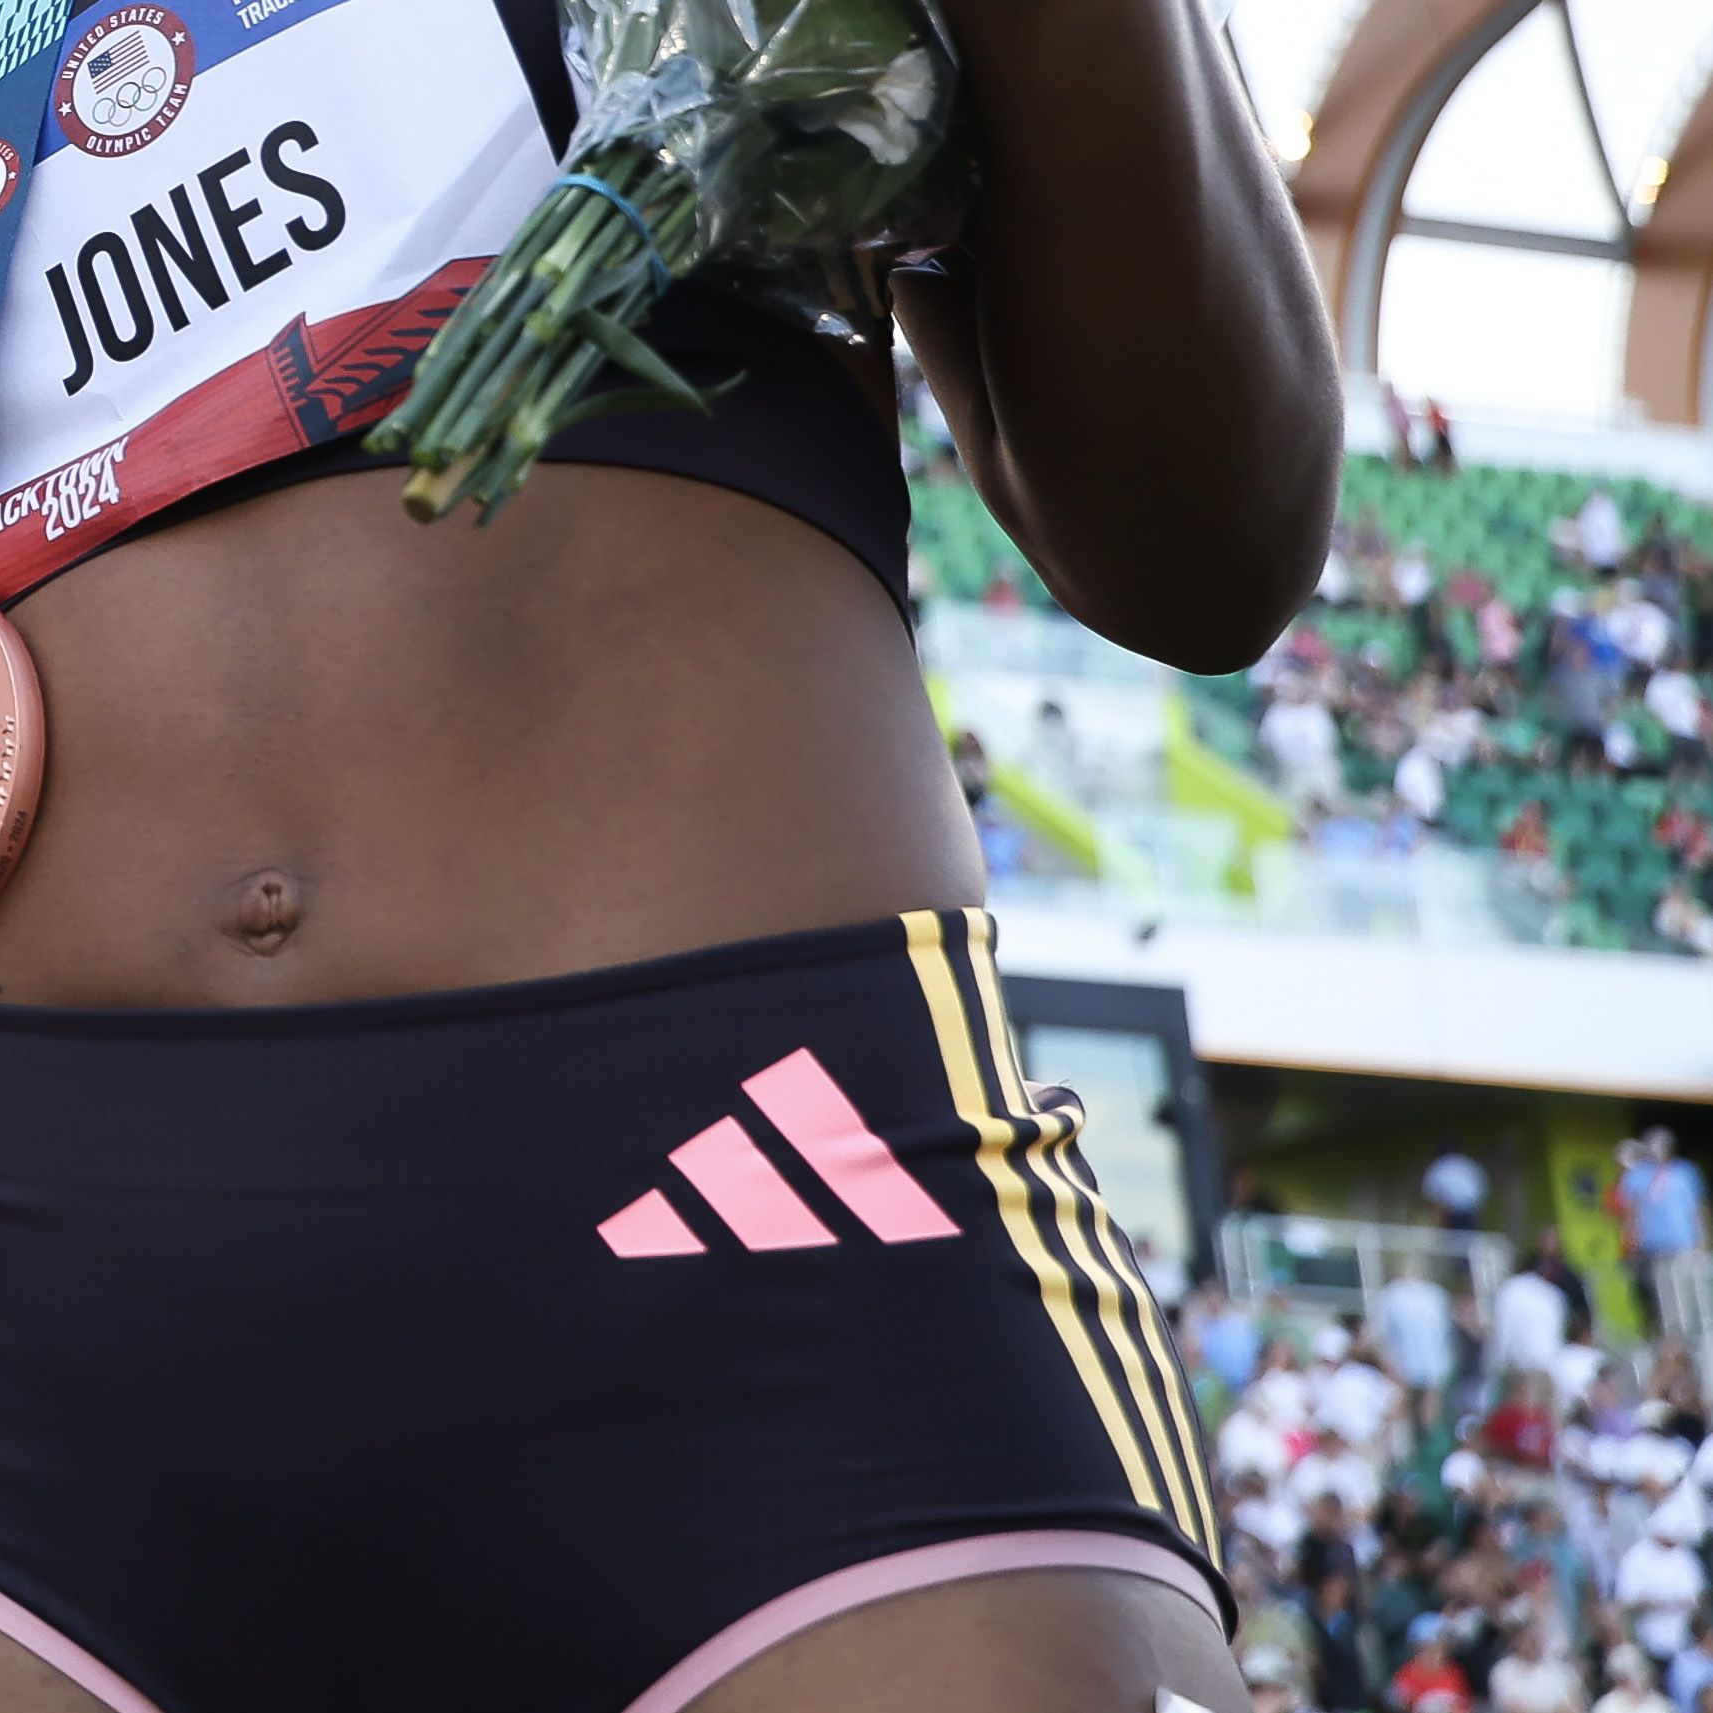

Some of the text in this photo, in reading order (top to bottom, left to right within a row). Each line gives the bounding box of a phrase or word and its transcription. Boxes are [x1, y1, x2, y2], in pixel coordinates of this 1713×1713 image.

[61, 7, 164, 80] UNITED STATES
[86, 83, 188, 153] OLYMPIC TEAM
[44, 119, 346, 397] JONES
[42, 458, 120, 541] 2024
